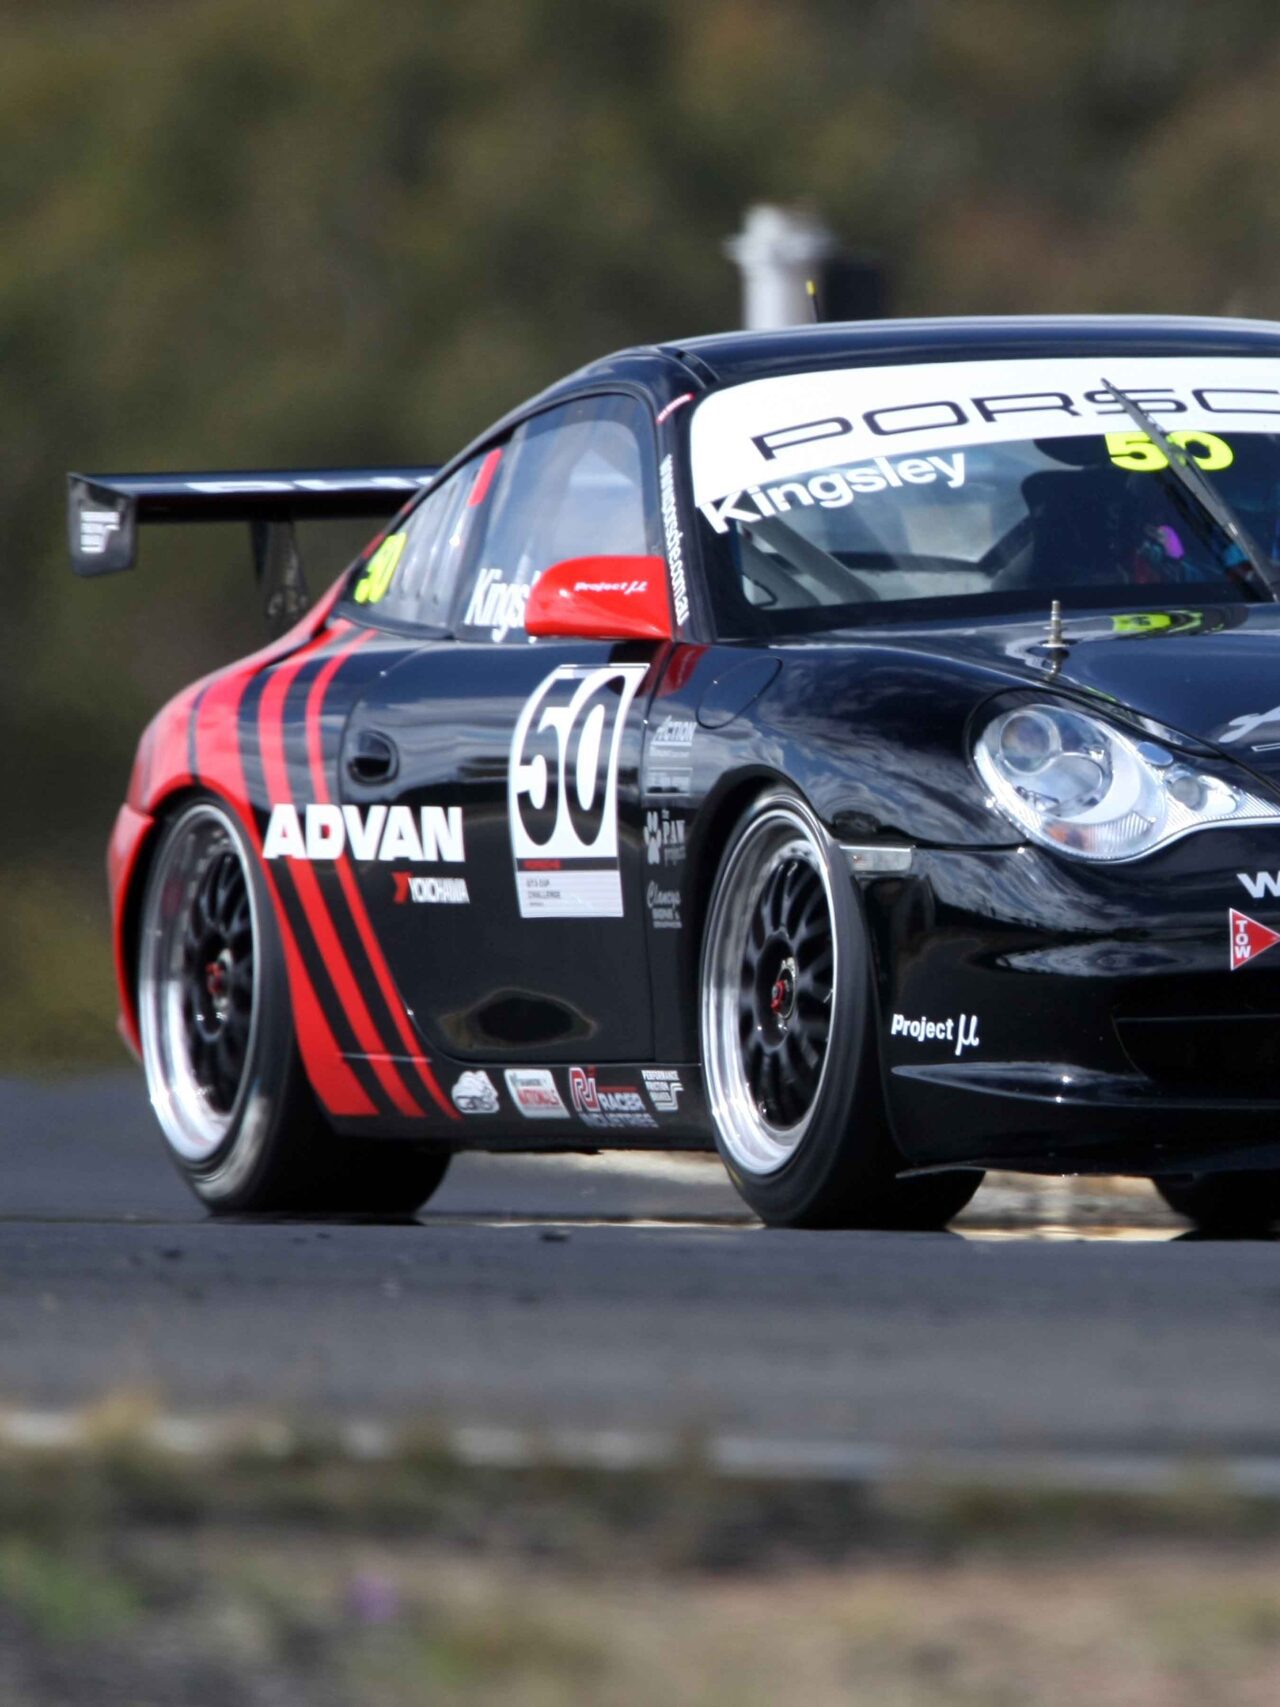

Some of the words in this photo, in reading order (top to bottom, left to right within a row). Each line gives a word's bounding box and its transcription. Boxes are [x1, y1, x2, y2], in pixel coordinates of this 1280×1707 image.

[1105, 430, 1234, 472] 50
[699, 451, 967, 534] Kingsley
[516, 674, 627, 847] 50
[262, 803, 467, 863] ADVAN
[1234, 919, 1252, 959] TOW
[890, 1013, 955, 1042] Project
